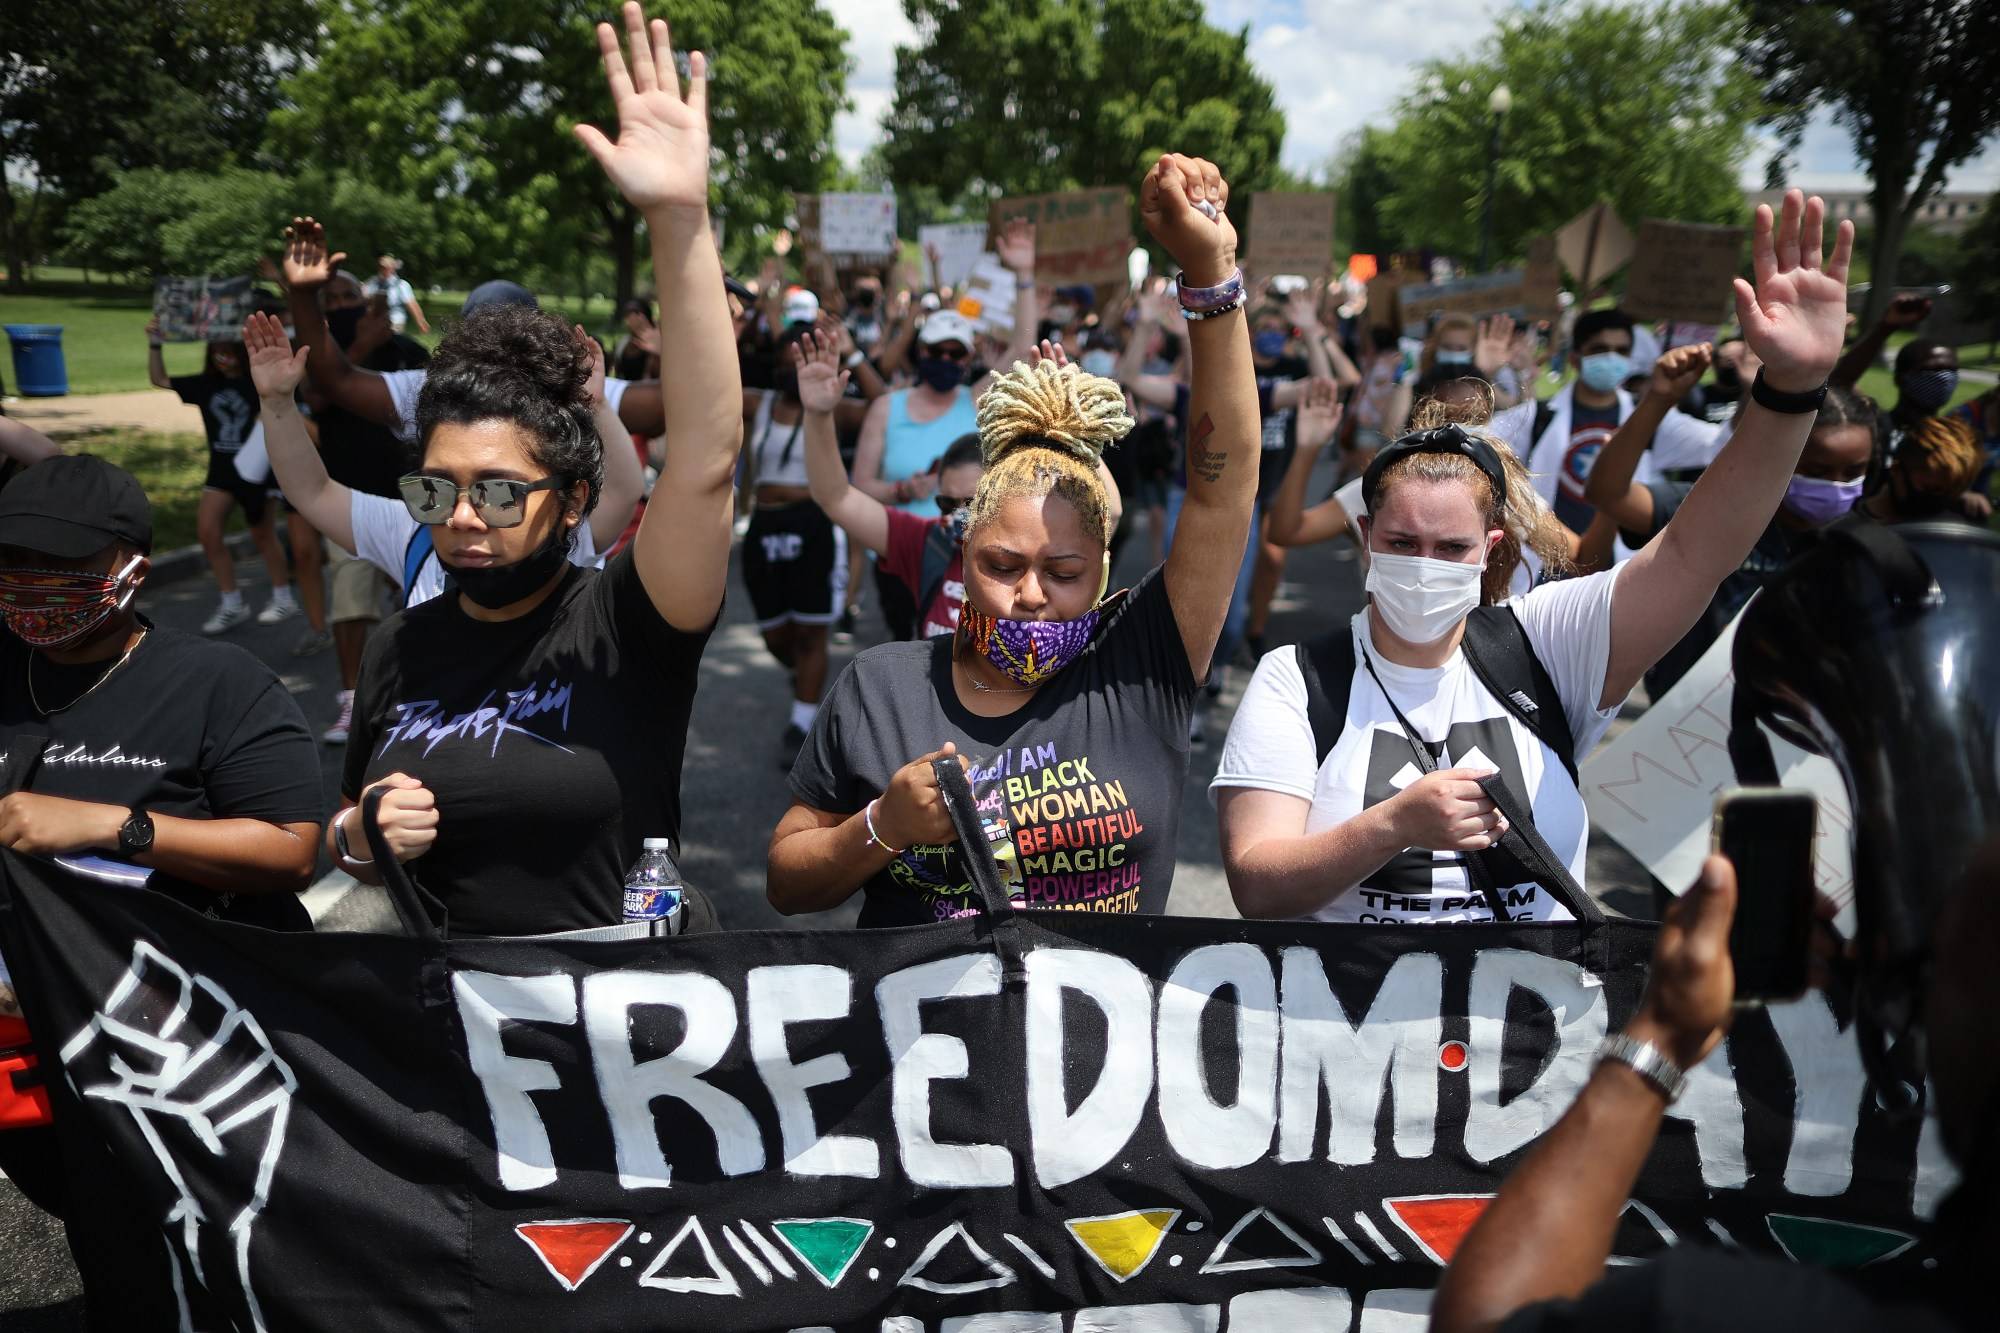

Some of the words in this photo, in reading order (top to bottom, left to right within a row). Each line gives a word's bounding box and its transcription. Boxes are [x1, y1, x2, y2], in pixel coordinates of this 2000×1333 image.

[1508, 690, 1539, 712] NIKE
[1006, 748, 1012, 776] I
[1020, 741, 1057, 773] AM
[1006, 756, 1097, 803] BLACK
[1011, 779, 1128, 826] WOMAN
[1016, 808, 1143, 856] BEAUTIFUL
[1023, 843, 1126, 875] MAGIC
[624, 892, 644, 902] DEER
[1027, 862, 1141, 903] POWERFUL
[1359, 890, 1432, 912] THE
[1442, 886, 1536, 910] PAM
[623, 901, 644, 912] PARK
[450, 942, 1443, 1190] FREEDOM
